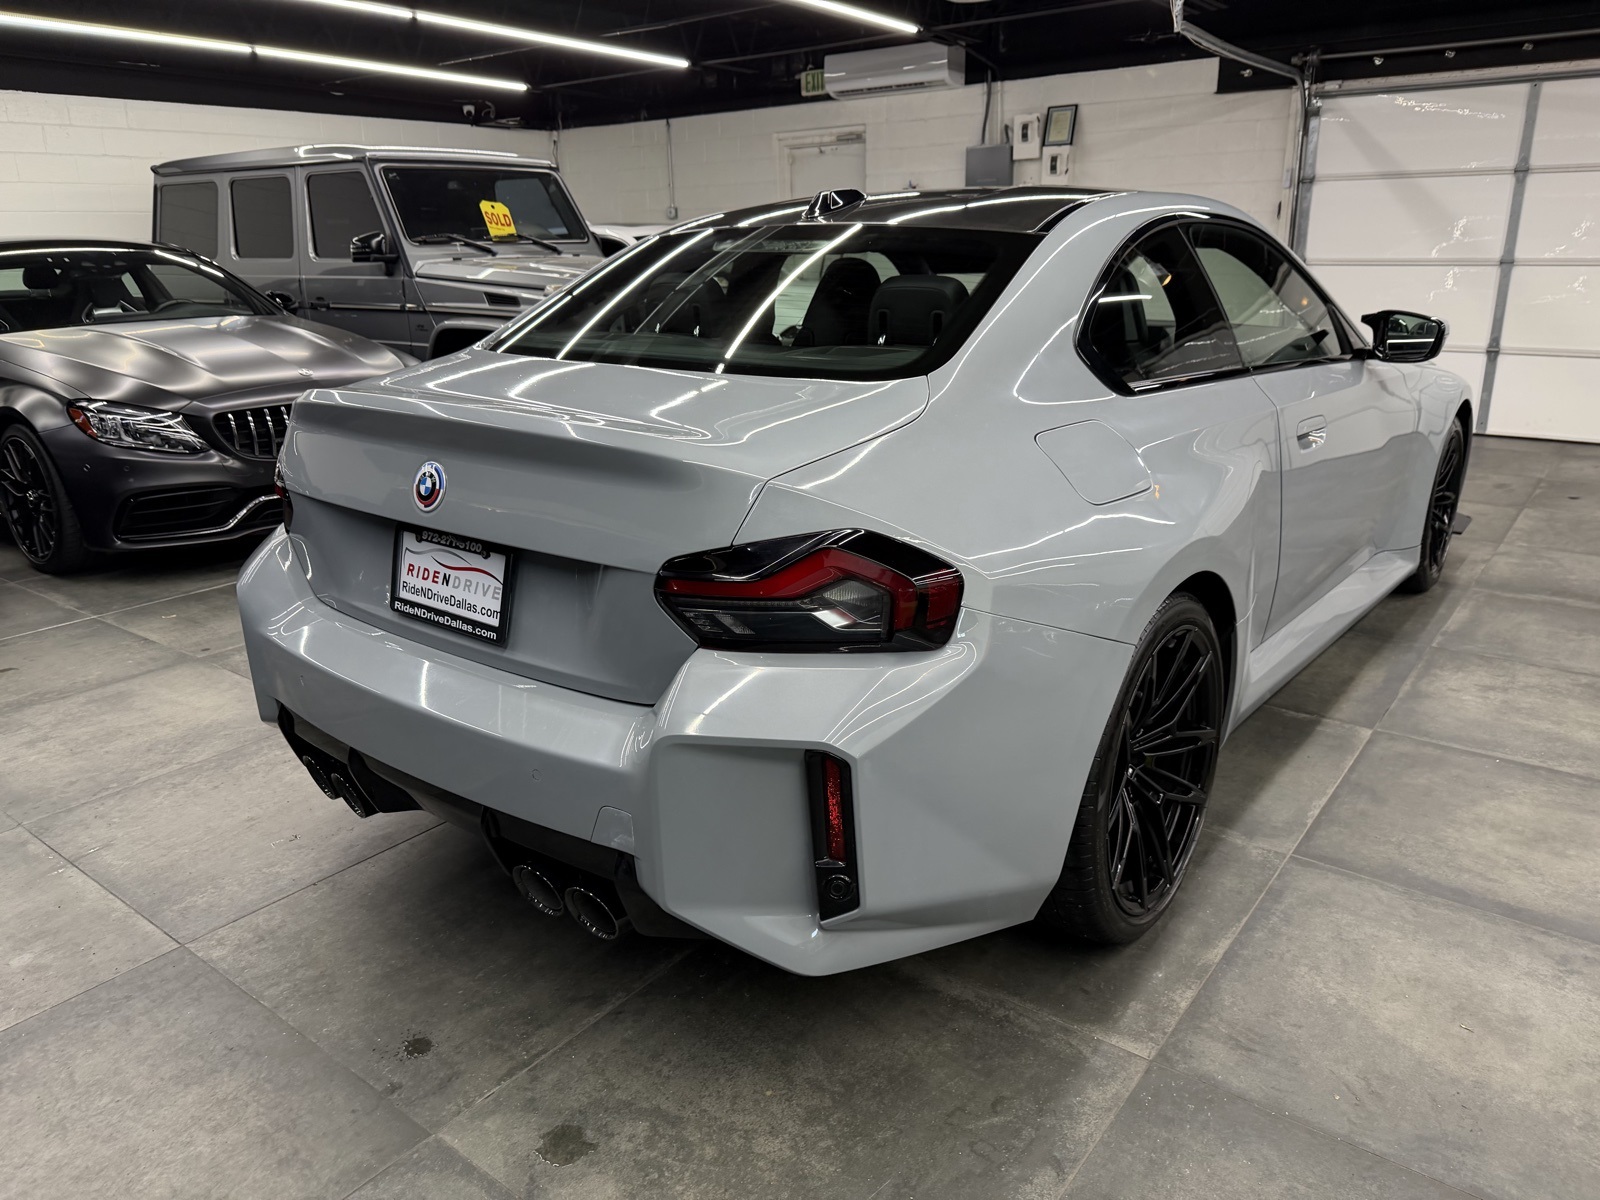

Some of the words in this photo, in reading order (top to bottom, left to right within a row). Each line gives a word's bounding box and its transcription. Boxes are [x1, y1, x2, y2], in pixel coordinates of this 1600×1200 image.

[805, 72, 824, 93] EXIT
[484, 211, 512, 227] SOLD
[402, 580, 501, 620] RideNDriveDallas.com
[394, 601, 497, 640] RideNDriveDallas.com
